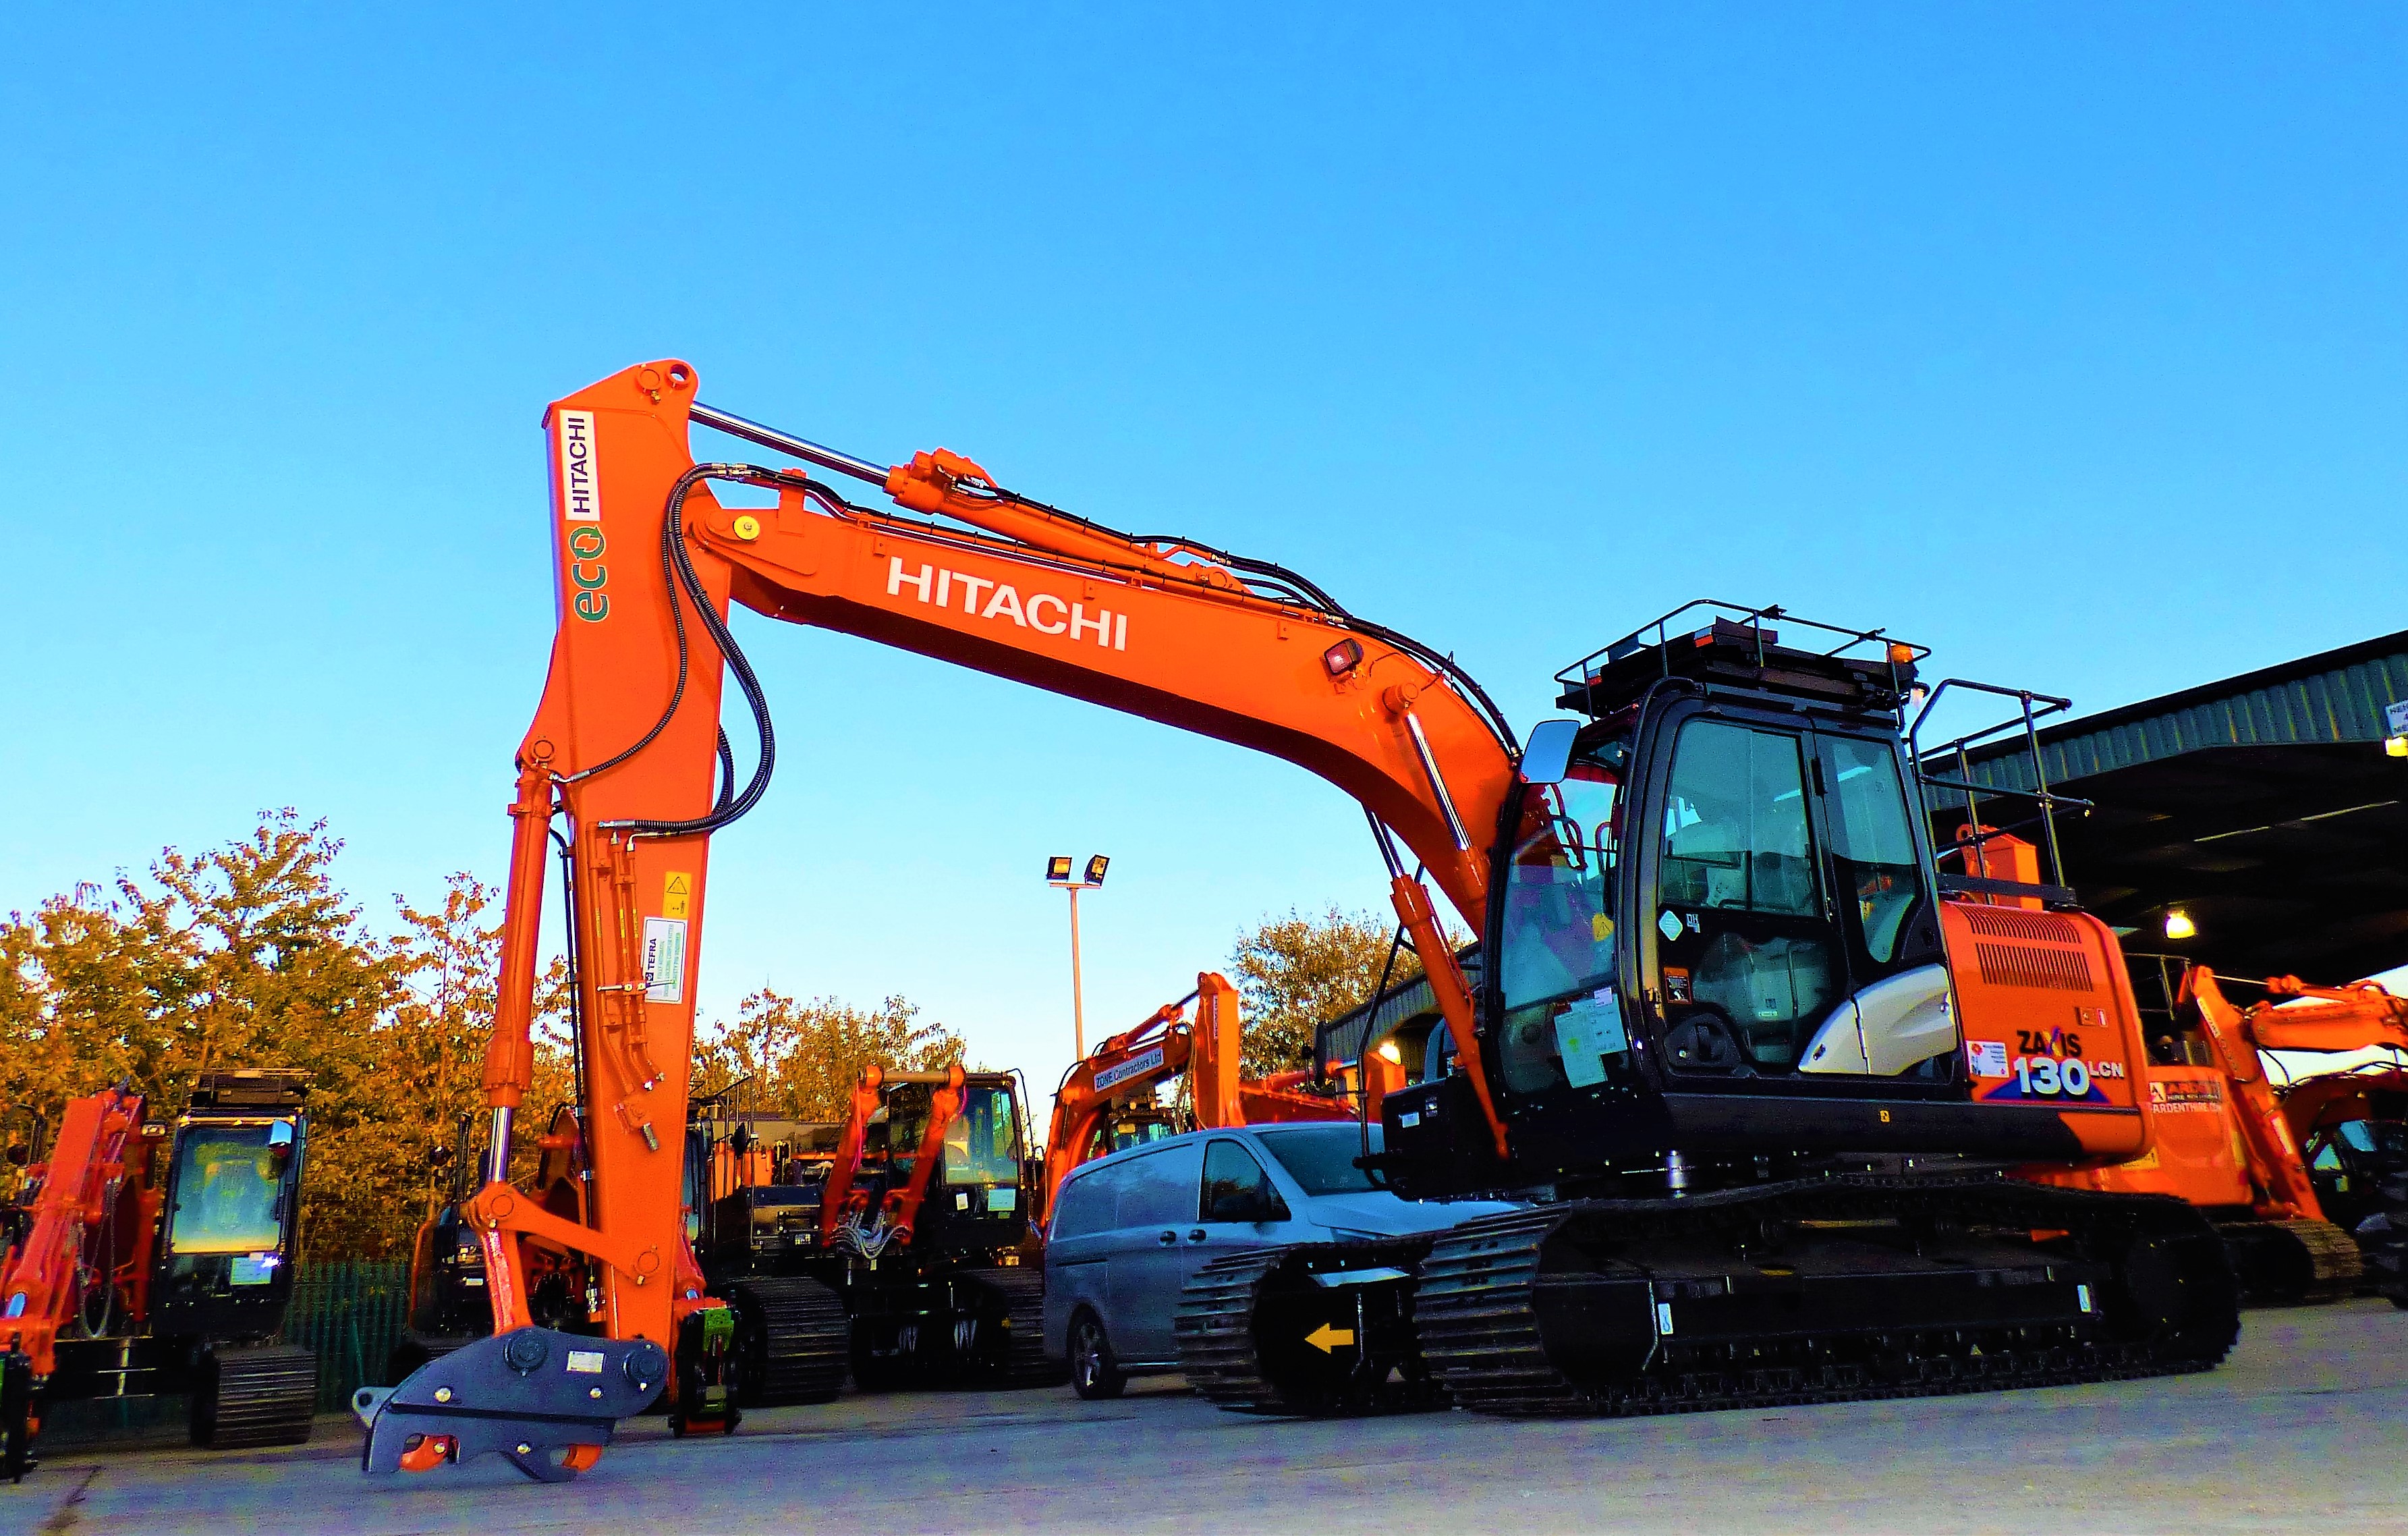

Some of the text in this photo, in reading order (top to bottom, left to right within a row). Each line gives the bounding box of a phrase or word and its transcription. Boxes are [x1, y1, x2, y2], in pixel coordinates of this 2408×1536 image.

[567, 418, 591, 514] HITACHI
[569, 524, 610, 624] eco
[887, 555, 1127, 652] HITACHI
[648, 938, 656, 970] TEFRA
[1096, 1051, 1161, 1088] ZONE Contractors Ltd
[2013, 1056, 2090, 1096] 130
